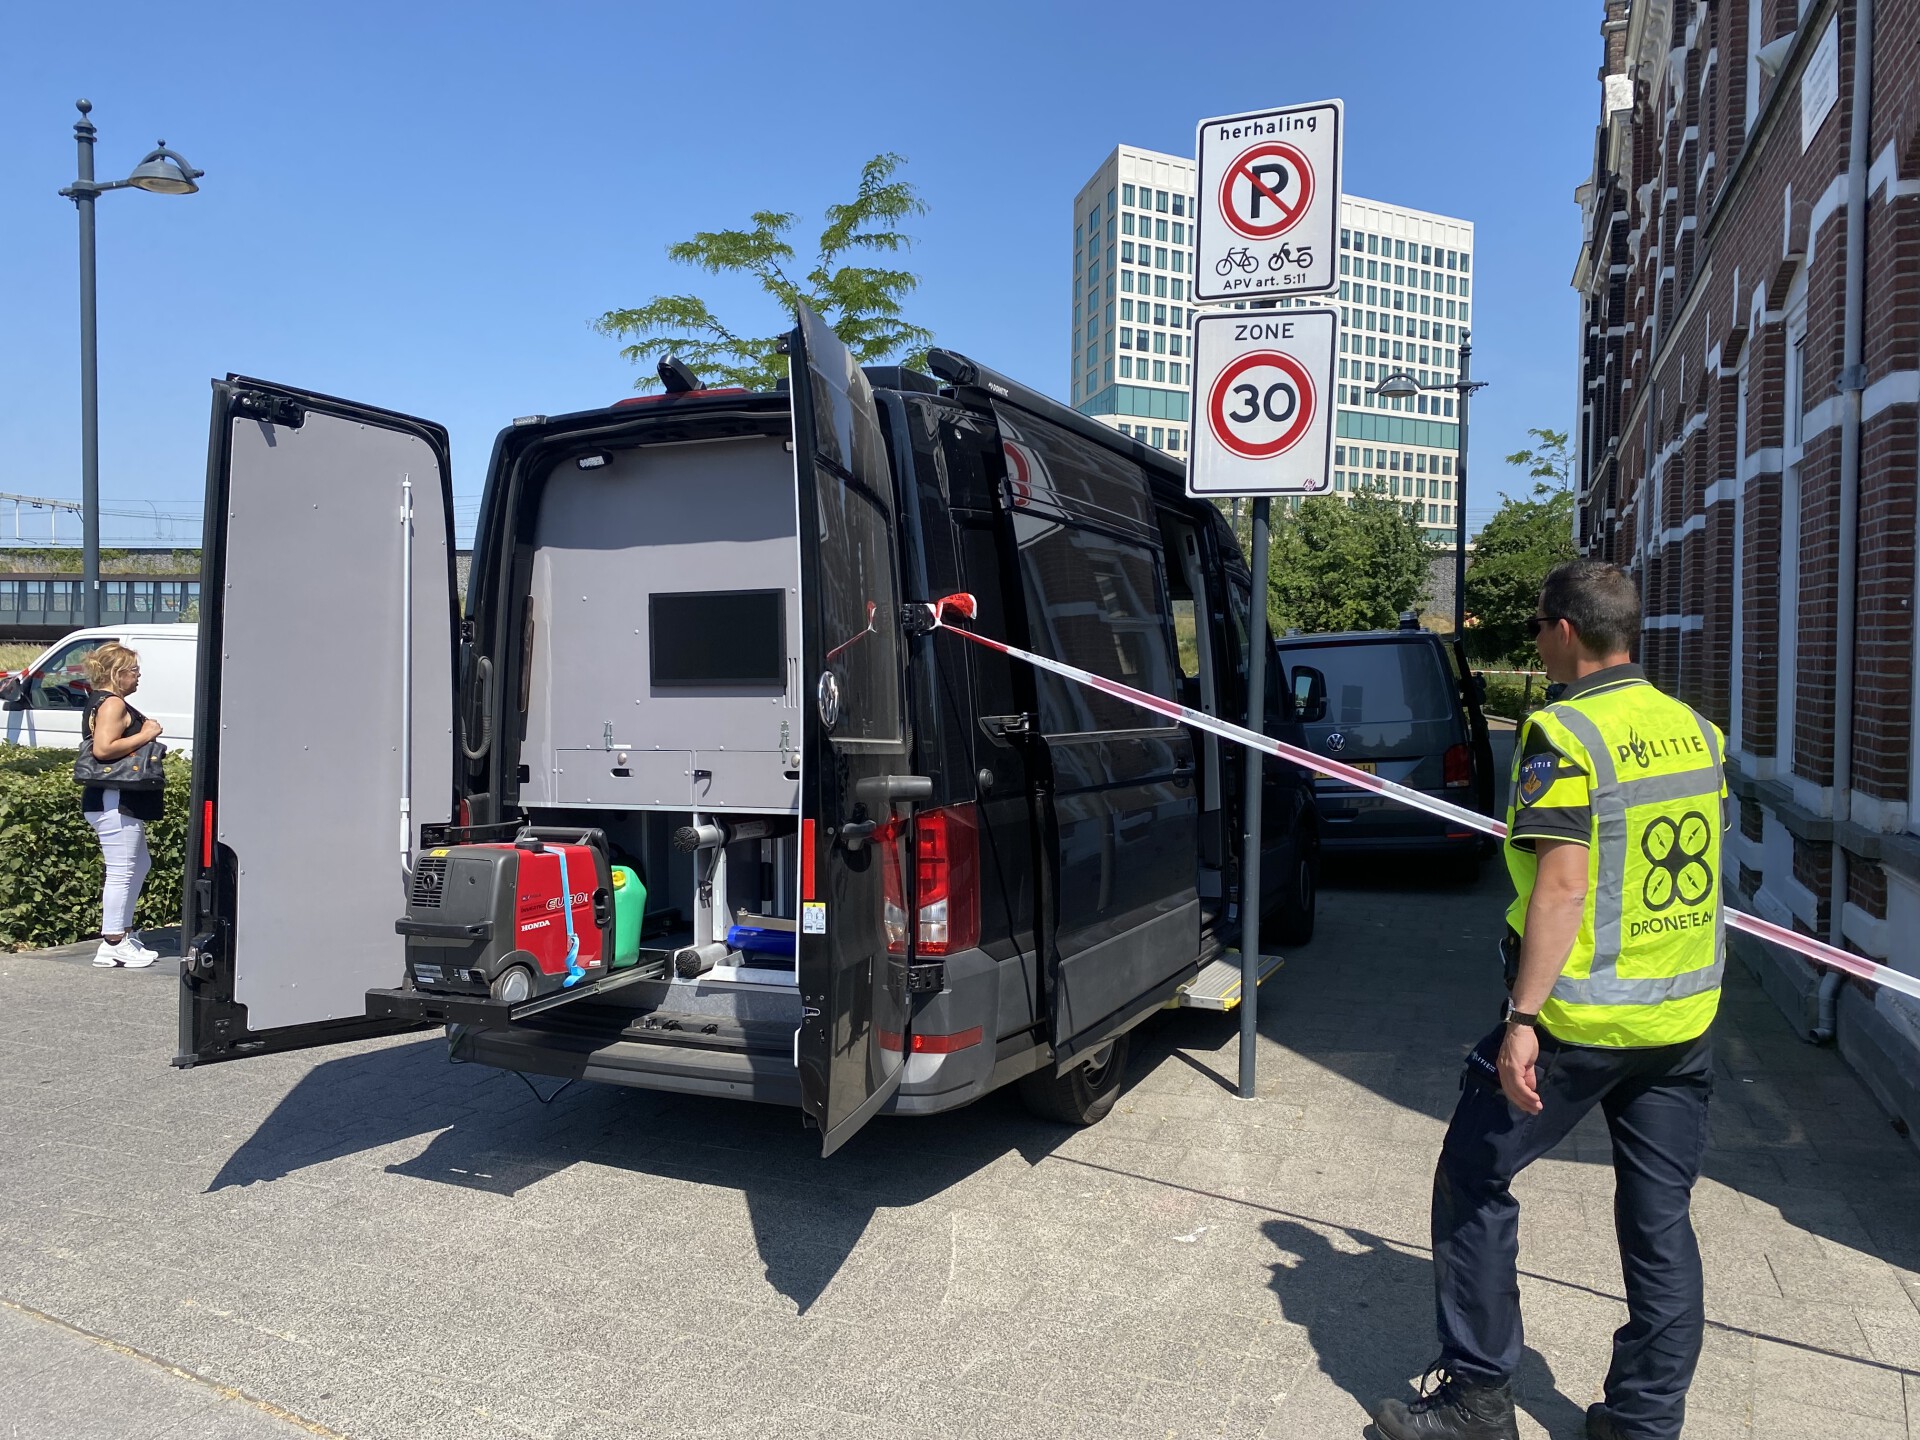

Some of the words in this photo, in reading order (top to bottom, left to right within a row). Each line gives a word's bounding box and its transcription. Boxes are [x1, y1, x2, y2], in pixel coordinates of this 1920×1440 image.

[1219, 116, 1317, 141] herhaling
[1250, 163, 1289, 219] P
[1223, 278, 1252, 290] APV
[1256, 276, 1279, 287] art.
[1284, 273, 1306, 284] 5:11
[1234, 322, 1294, 341] ZONE
[1229, 382, 1297, 423] 30
[1617, 735, 1704, 769] POLITIE
[520, 920, 551, 932] HONDA
